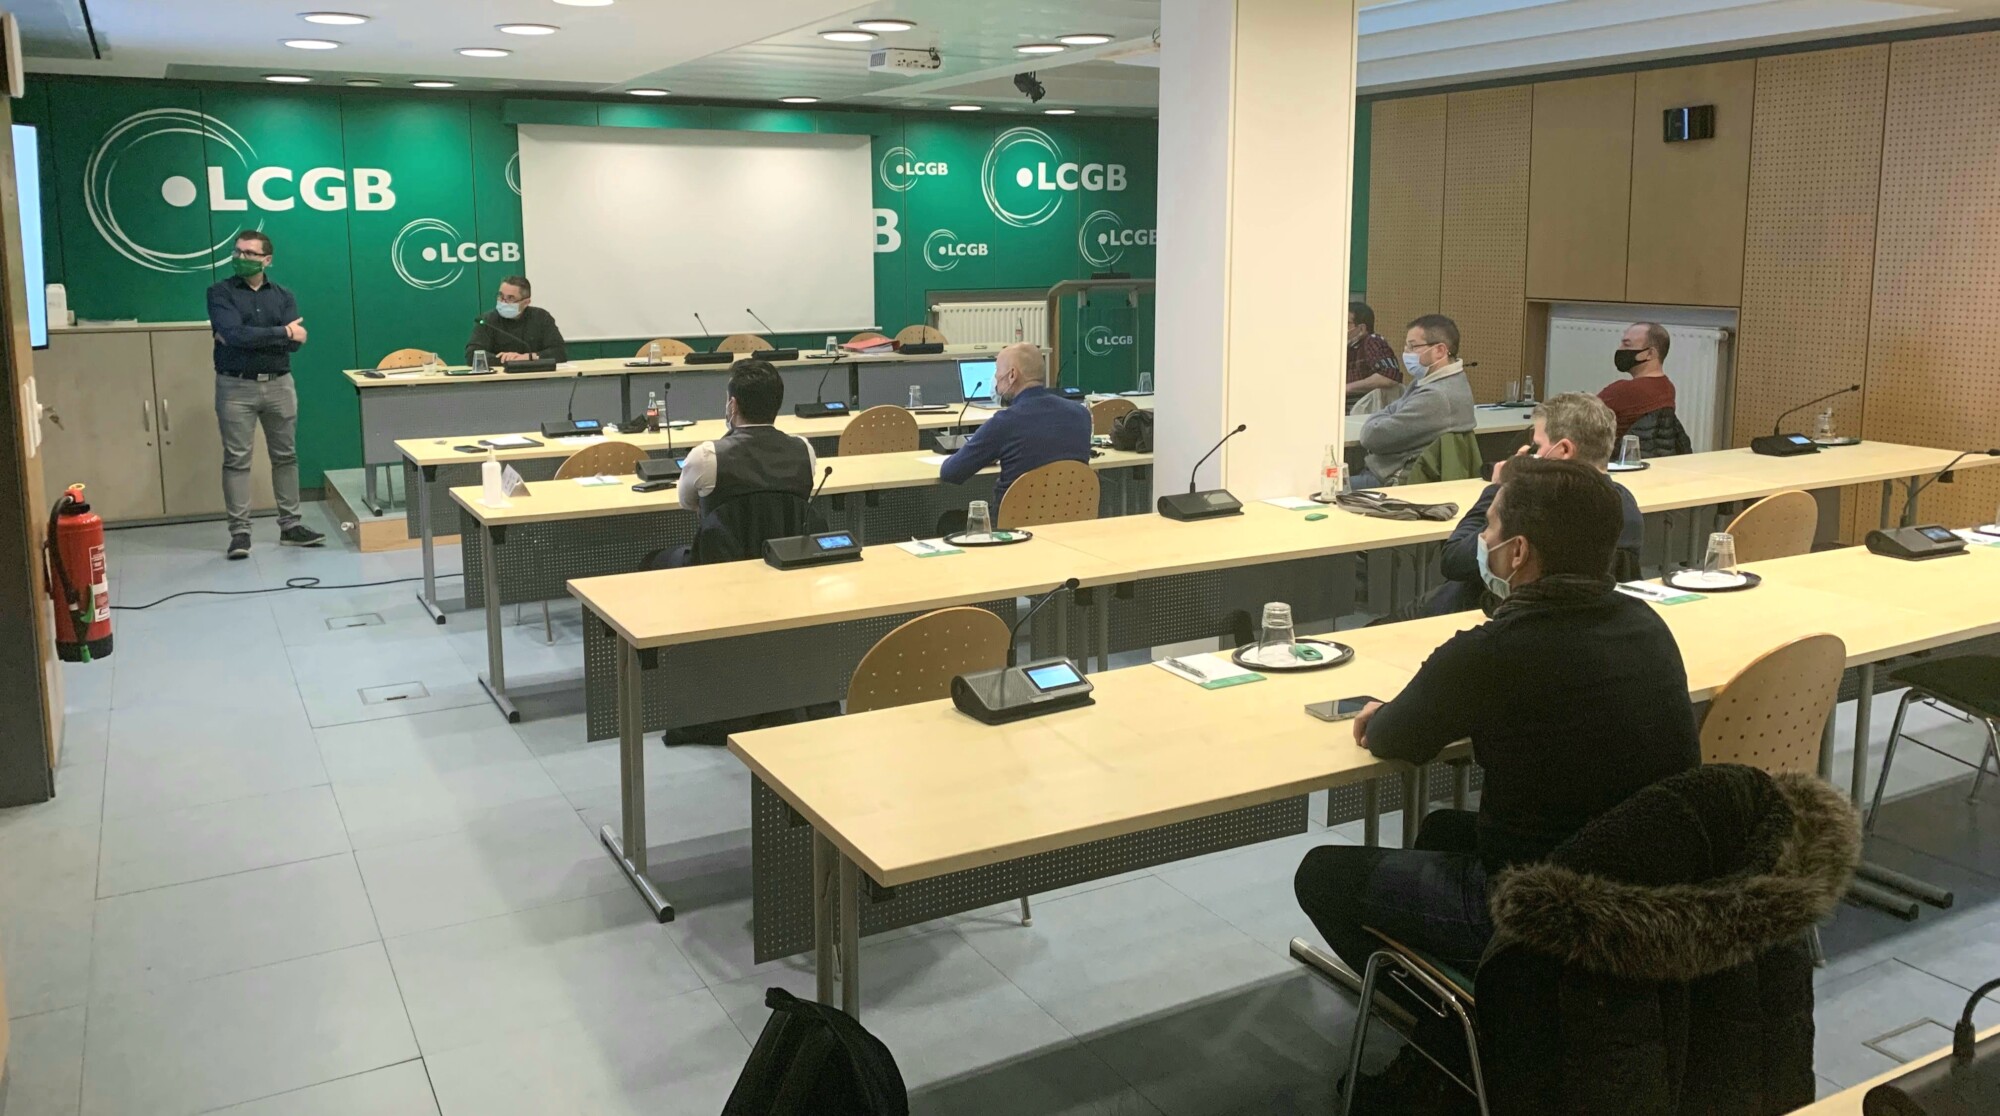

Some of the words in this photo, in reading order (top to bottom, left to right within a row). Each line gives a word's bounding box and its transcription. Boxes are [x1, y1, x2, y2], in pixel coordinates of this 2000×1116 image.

[905, 162, 948, 176] LCGB
[1037, 162, 1128, 191] LCGB
[207, 166, 396, 211] LCGB
[440, 242, 521, 263] LCGB
[947, 243, 989, 256] LCGB
[1104, 335, 1133, 346] LCGB
